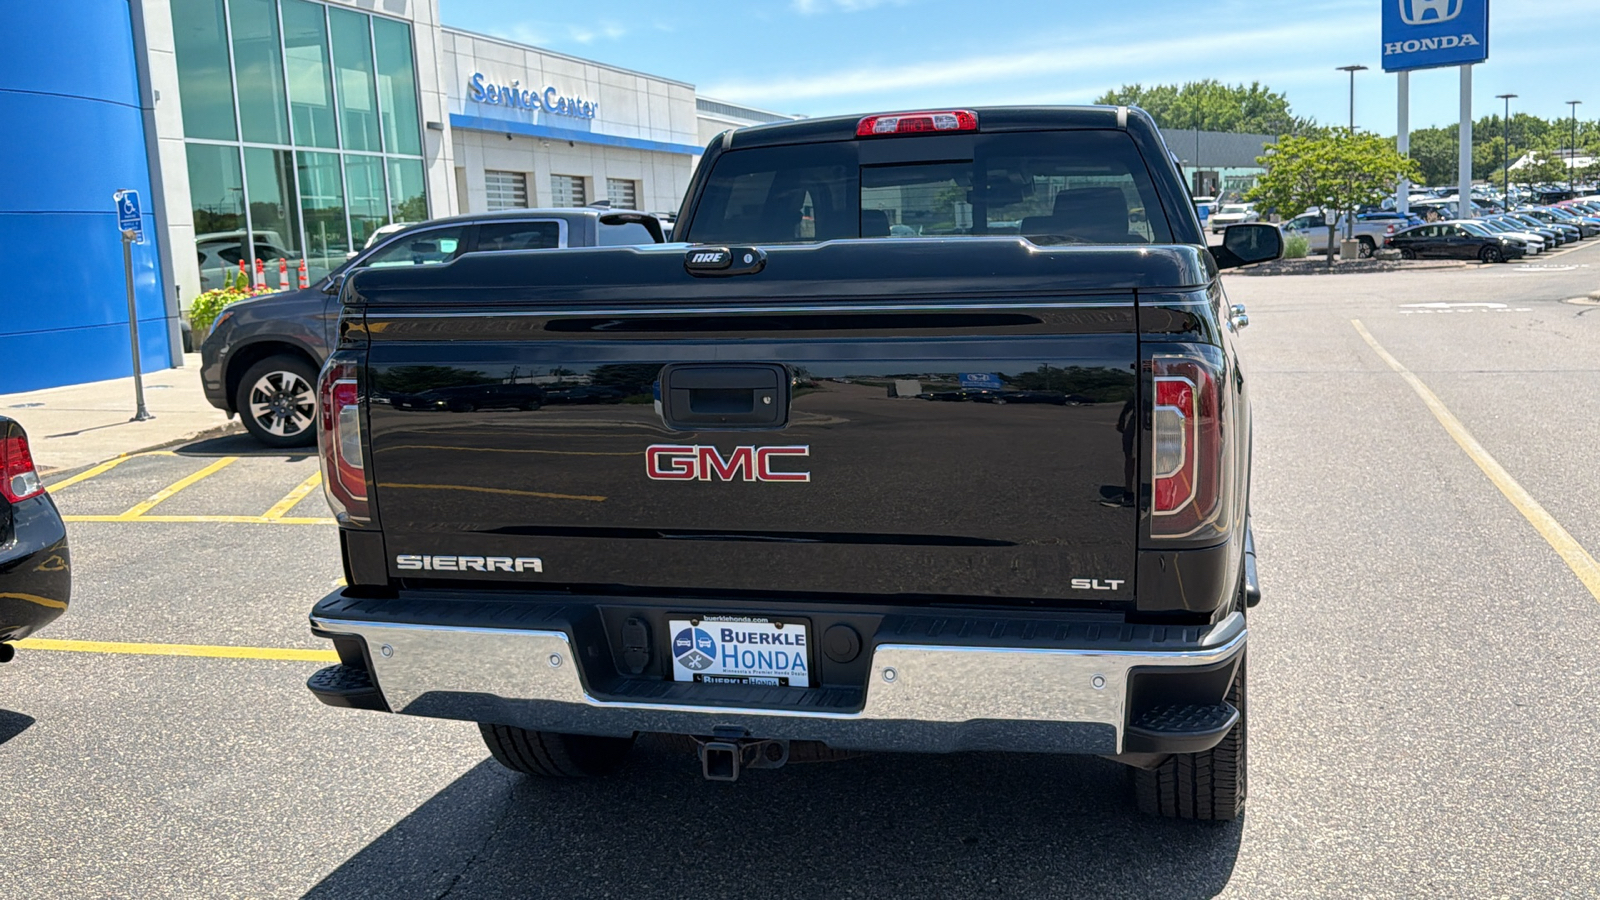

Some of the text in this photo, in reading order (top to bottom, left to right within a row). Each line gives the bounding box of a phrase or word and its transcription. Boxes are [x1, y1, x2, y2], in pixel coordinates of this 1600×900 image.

[1384, 33, 1480, 56] HONDA
[471, 72, 598, 119] Service Center
[691, 252, 724, 263] ARE
[645, 444, 811, 482] GMC
[396, 554, 543, 573] SIERRA
[1071, 578, 1125, 590] SLT
[703, 615, 769, 623] buerklehonda.com
[720, 627, 806, 646] BUERKLE
[721, 644, 807, 672] HONDA
